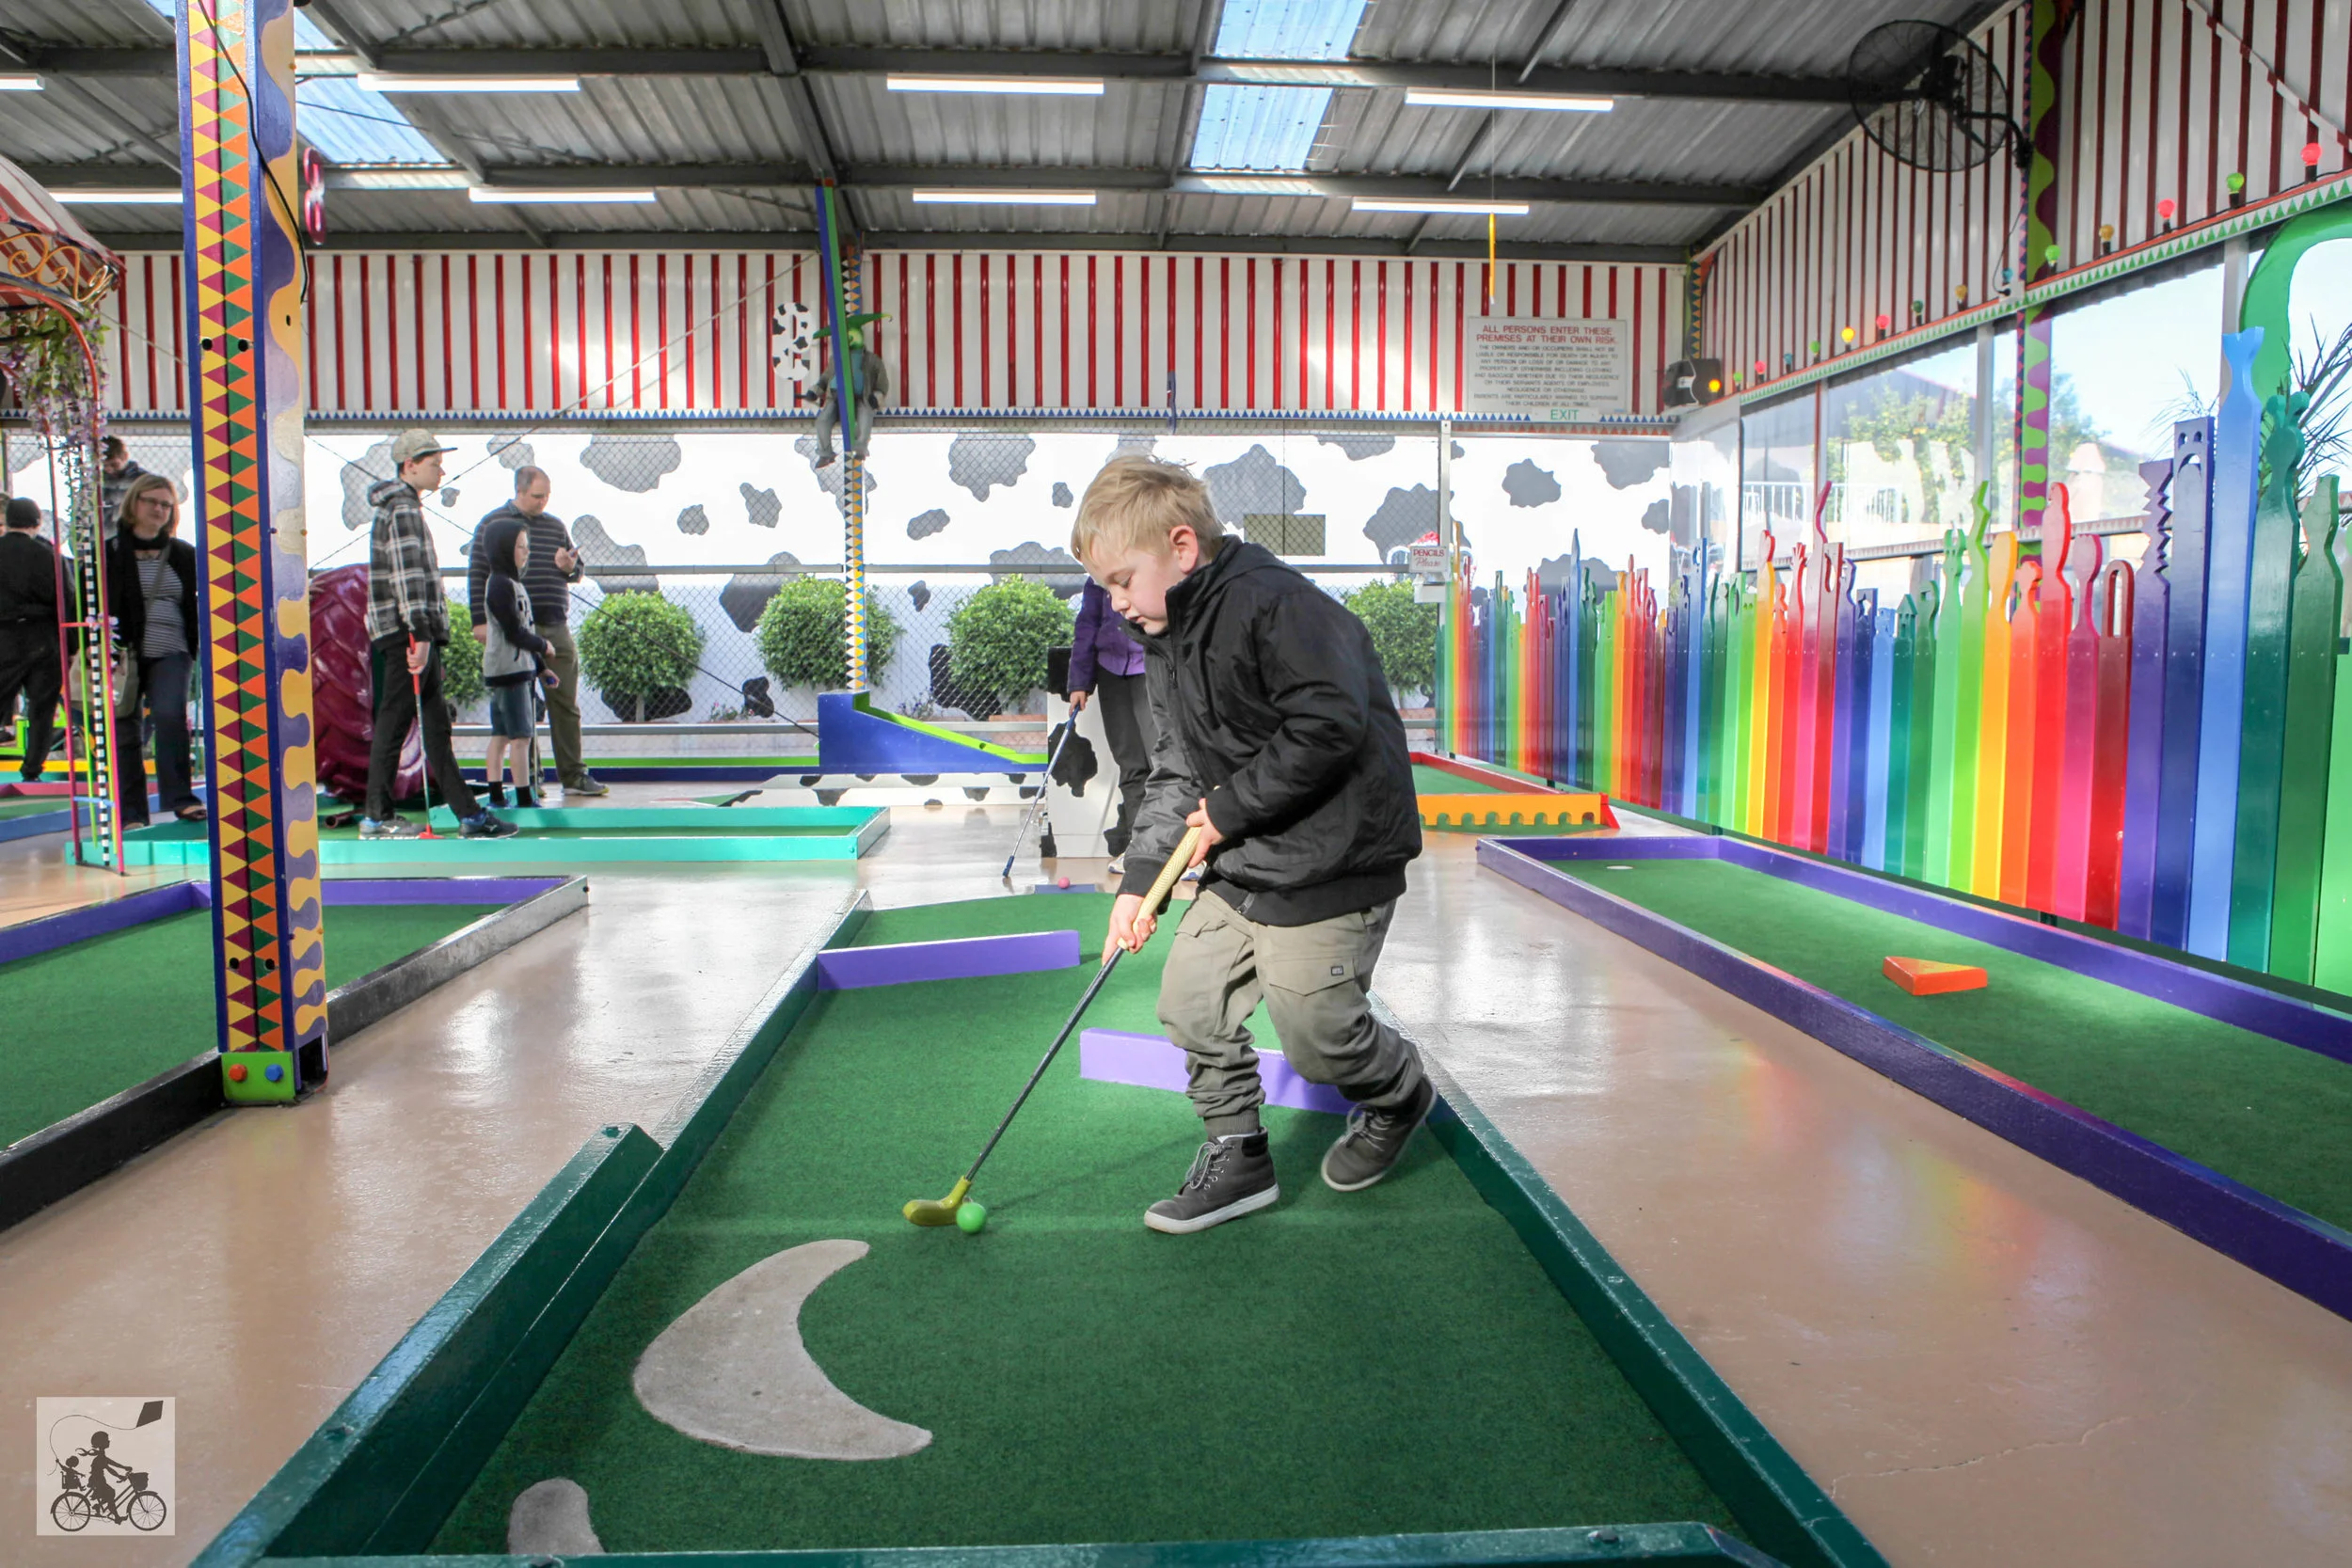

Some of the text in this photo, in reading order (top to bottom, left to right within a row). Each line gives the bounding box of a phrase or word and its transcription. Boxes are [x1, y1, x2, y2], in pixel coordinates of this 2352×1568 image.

[1483, 325, 1612, 336] ALL PERSONS ENTER THESE
[1476, 333, 1521, 343] PREMISES
[1526, 334, 1536, 343] AT
[1541, 334, 1565, 343] THEIR
[1570, 335, 1592, 344] OWN
[1550, 409, 1580, 420] EXIT
[1413, 548, 1445, 557] PENCILS
